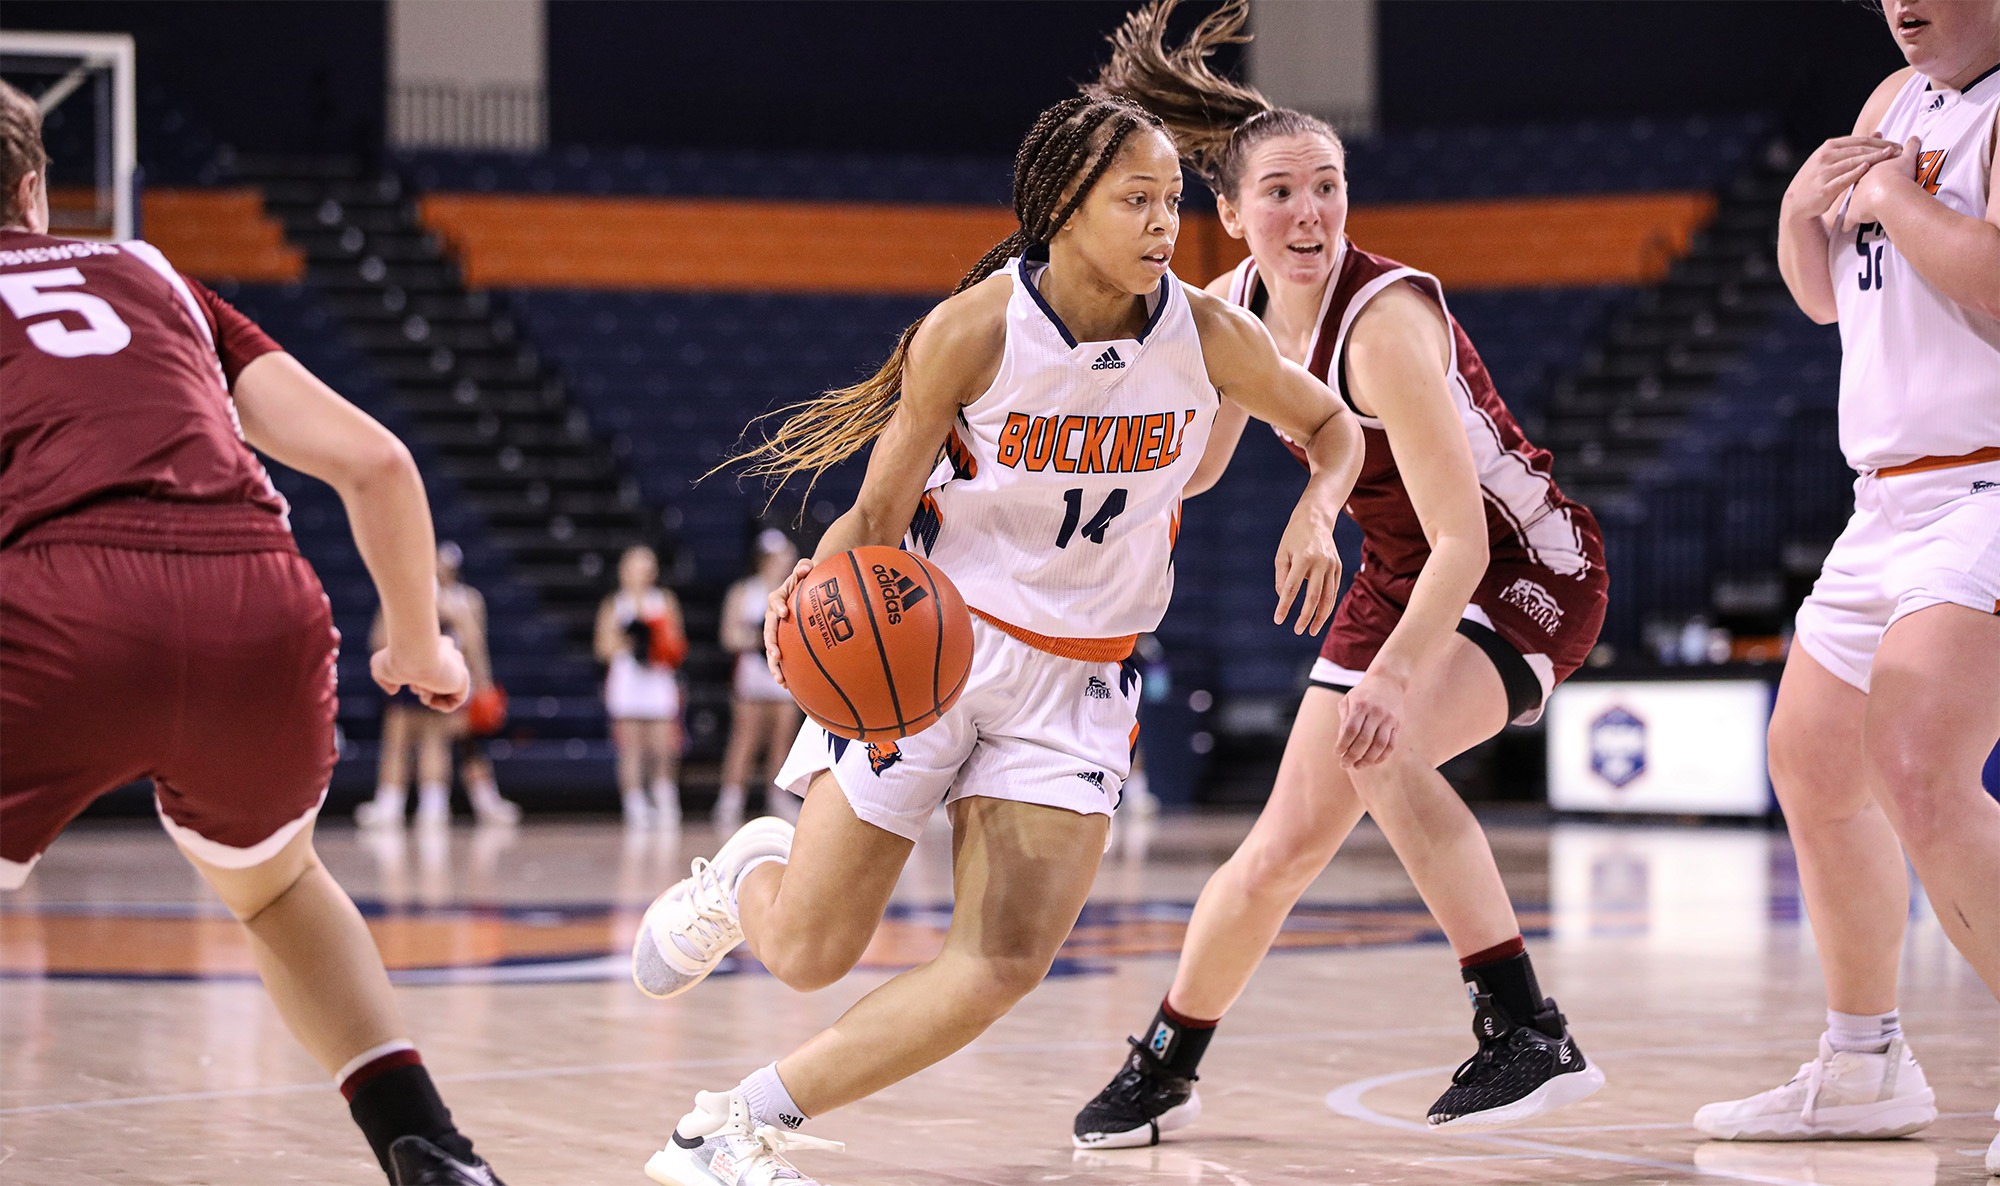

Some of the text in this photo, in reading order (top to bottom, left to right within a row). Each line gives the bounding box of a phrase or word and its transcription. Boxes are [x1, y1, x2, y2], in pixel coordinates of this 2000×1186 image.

[0, 243, 119, 266] BIEWSKI
[0, 267, 131, 358] 5
[1091, 360, 1126, 371] adidas
[1055, 488, 1128, 549] 14
[818, 577, 855, 642] PRO
[872, 564, 901, 625] adidas
[815, 613, 825, 631] GAME
[821, 632, 833, 650] BALL
[1077, 773, 1105, 794] adidas
